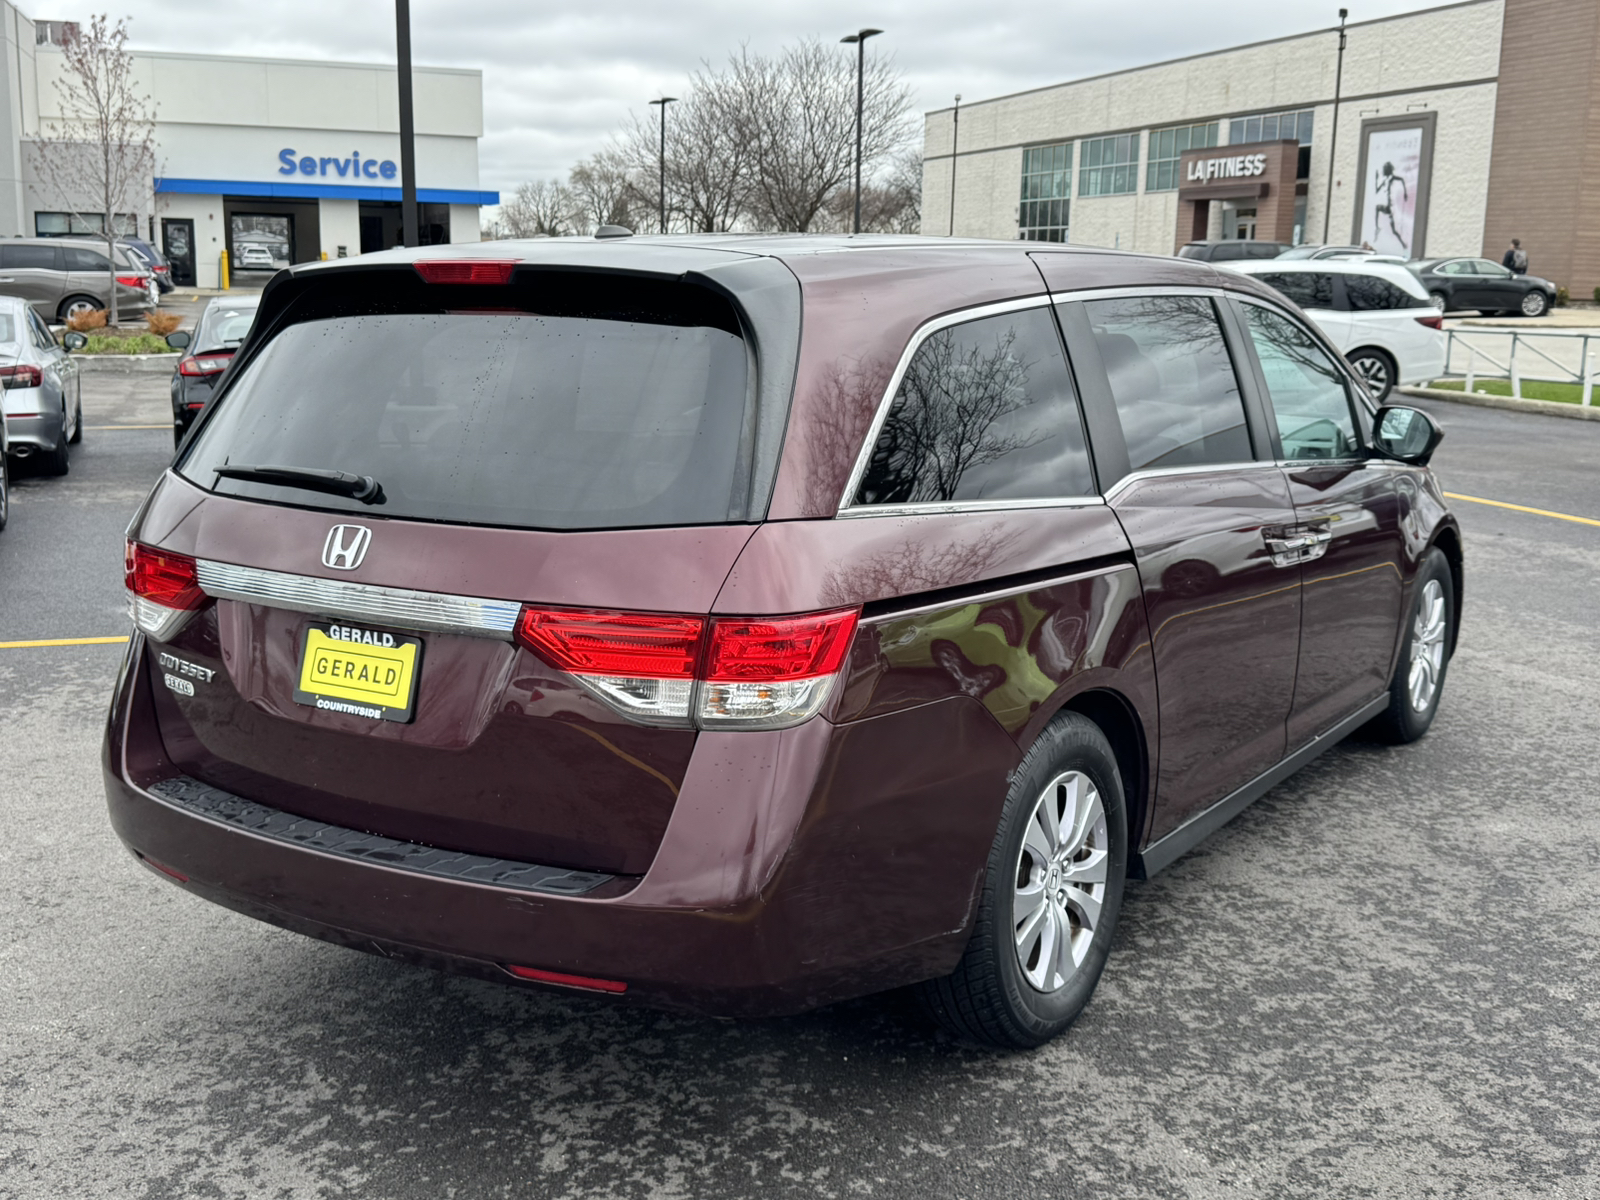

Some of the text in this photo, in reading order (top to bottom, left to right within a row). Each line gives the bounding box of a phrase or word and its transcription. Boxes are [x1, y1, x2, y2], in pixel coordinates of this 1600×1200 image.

[278, 148, 398, 179] Service
[1187, 153, 1267, 181] LA FITNESS
[329, 625, 394, 648] GERALD
[159, 651, 216, 684] ODYSSEY
[316, 657, 397, 686] GERALD
[316, 699, 381, 719] COUNTRYSIDE
